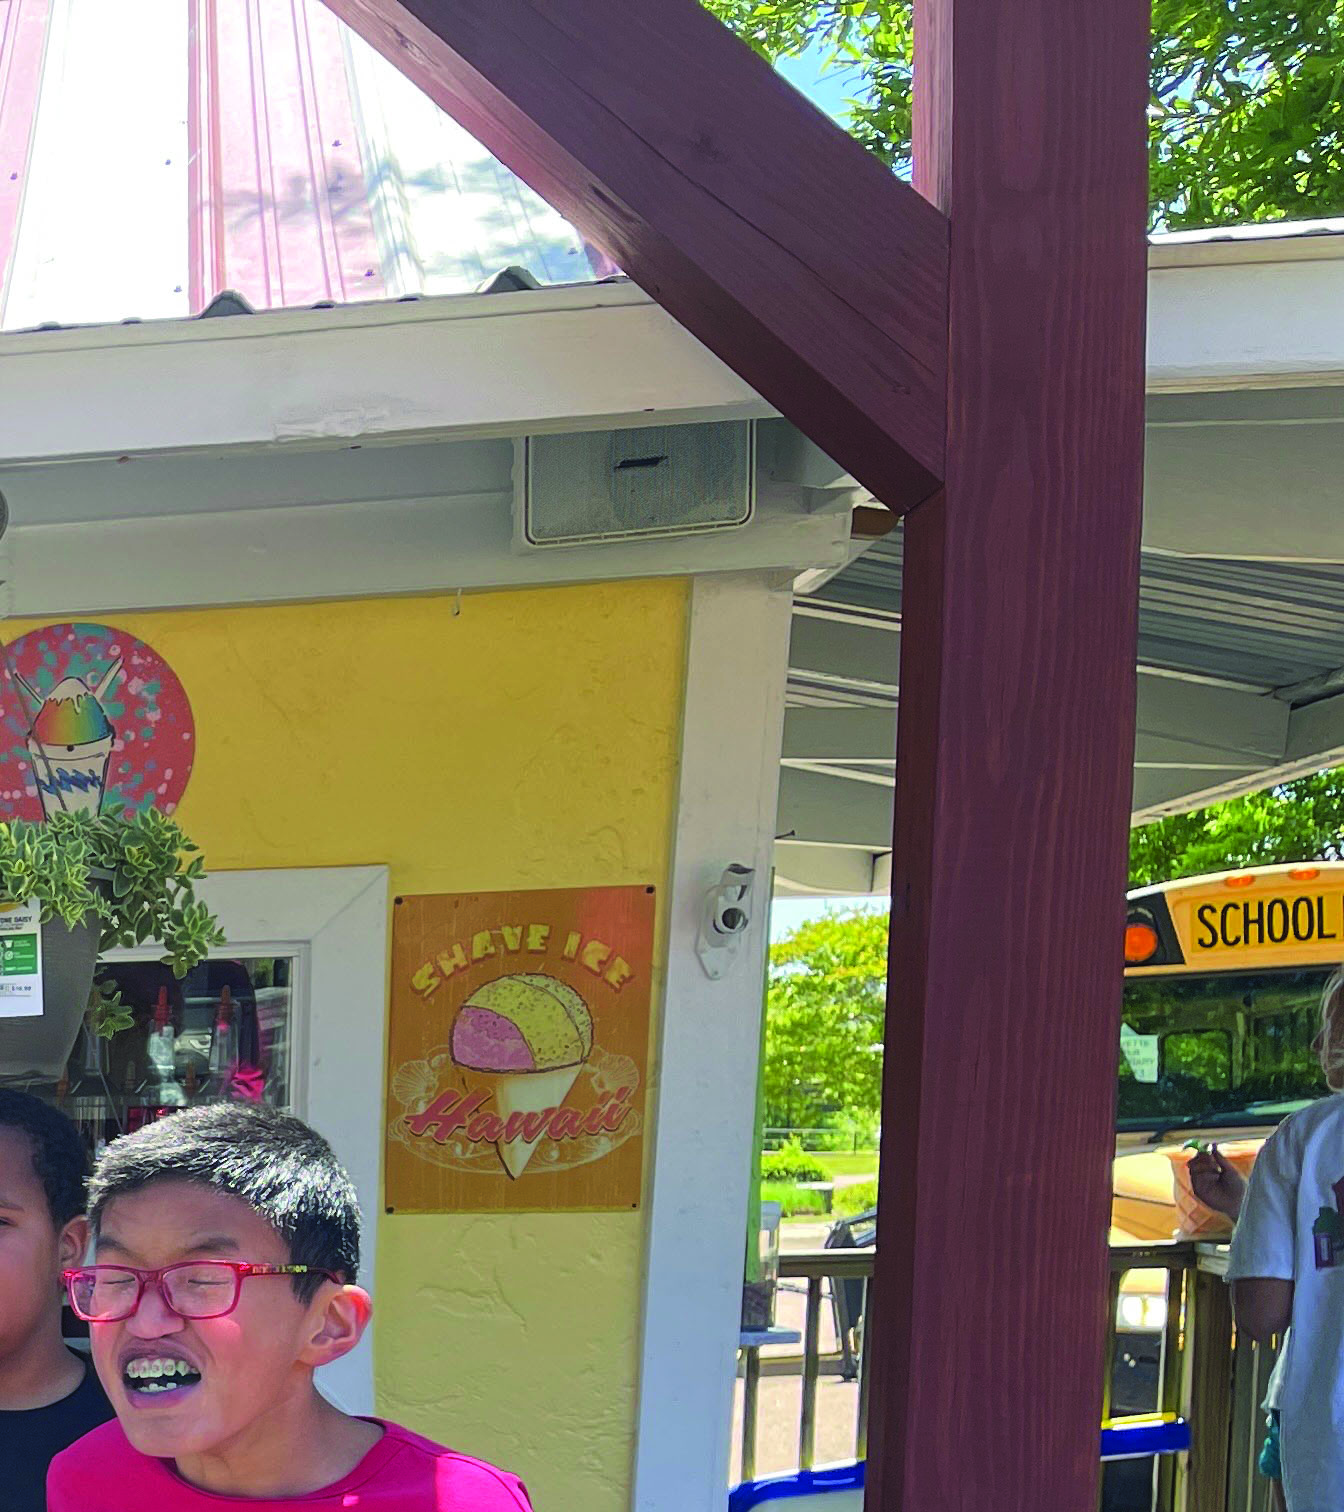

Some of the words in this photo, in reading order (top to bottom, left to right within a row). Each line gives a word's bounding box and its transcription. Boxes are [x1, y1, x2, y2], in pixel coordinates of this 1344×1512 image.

[1197, 896, 1337, 948] SCHOOL
[411, 923, 551, 998] SHAVE
[562, 931, 635, 994] ICE
[403, 1085, 634, 1145] Hawaii
